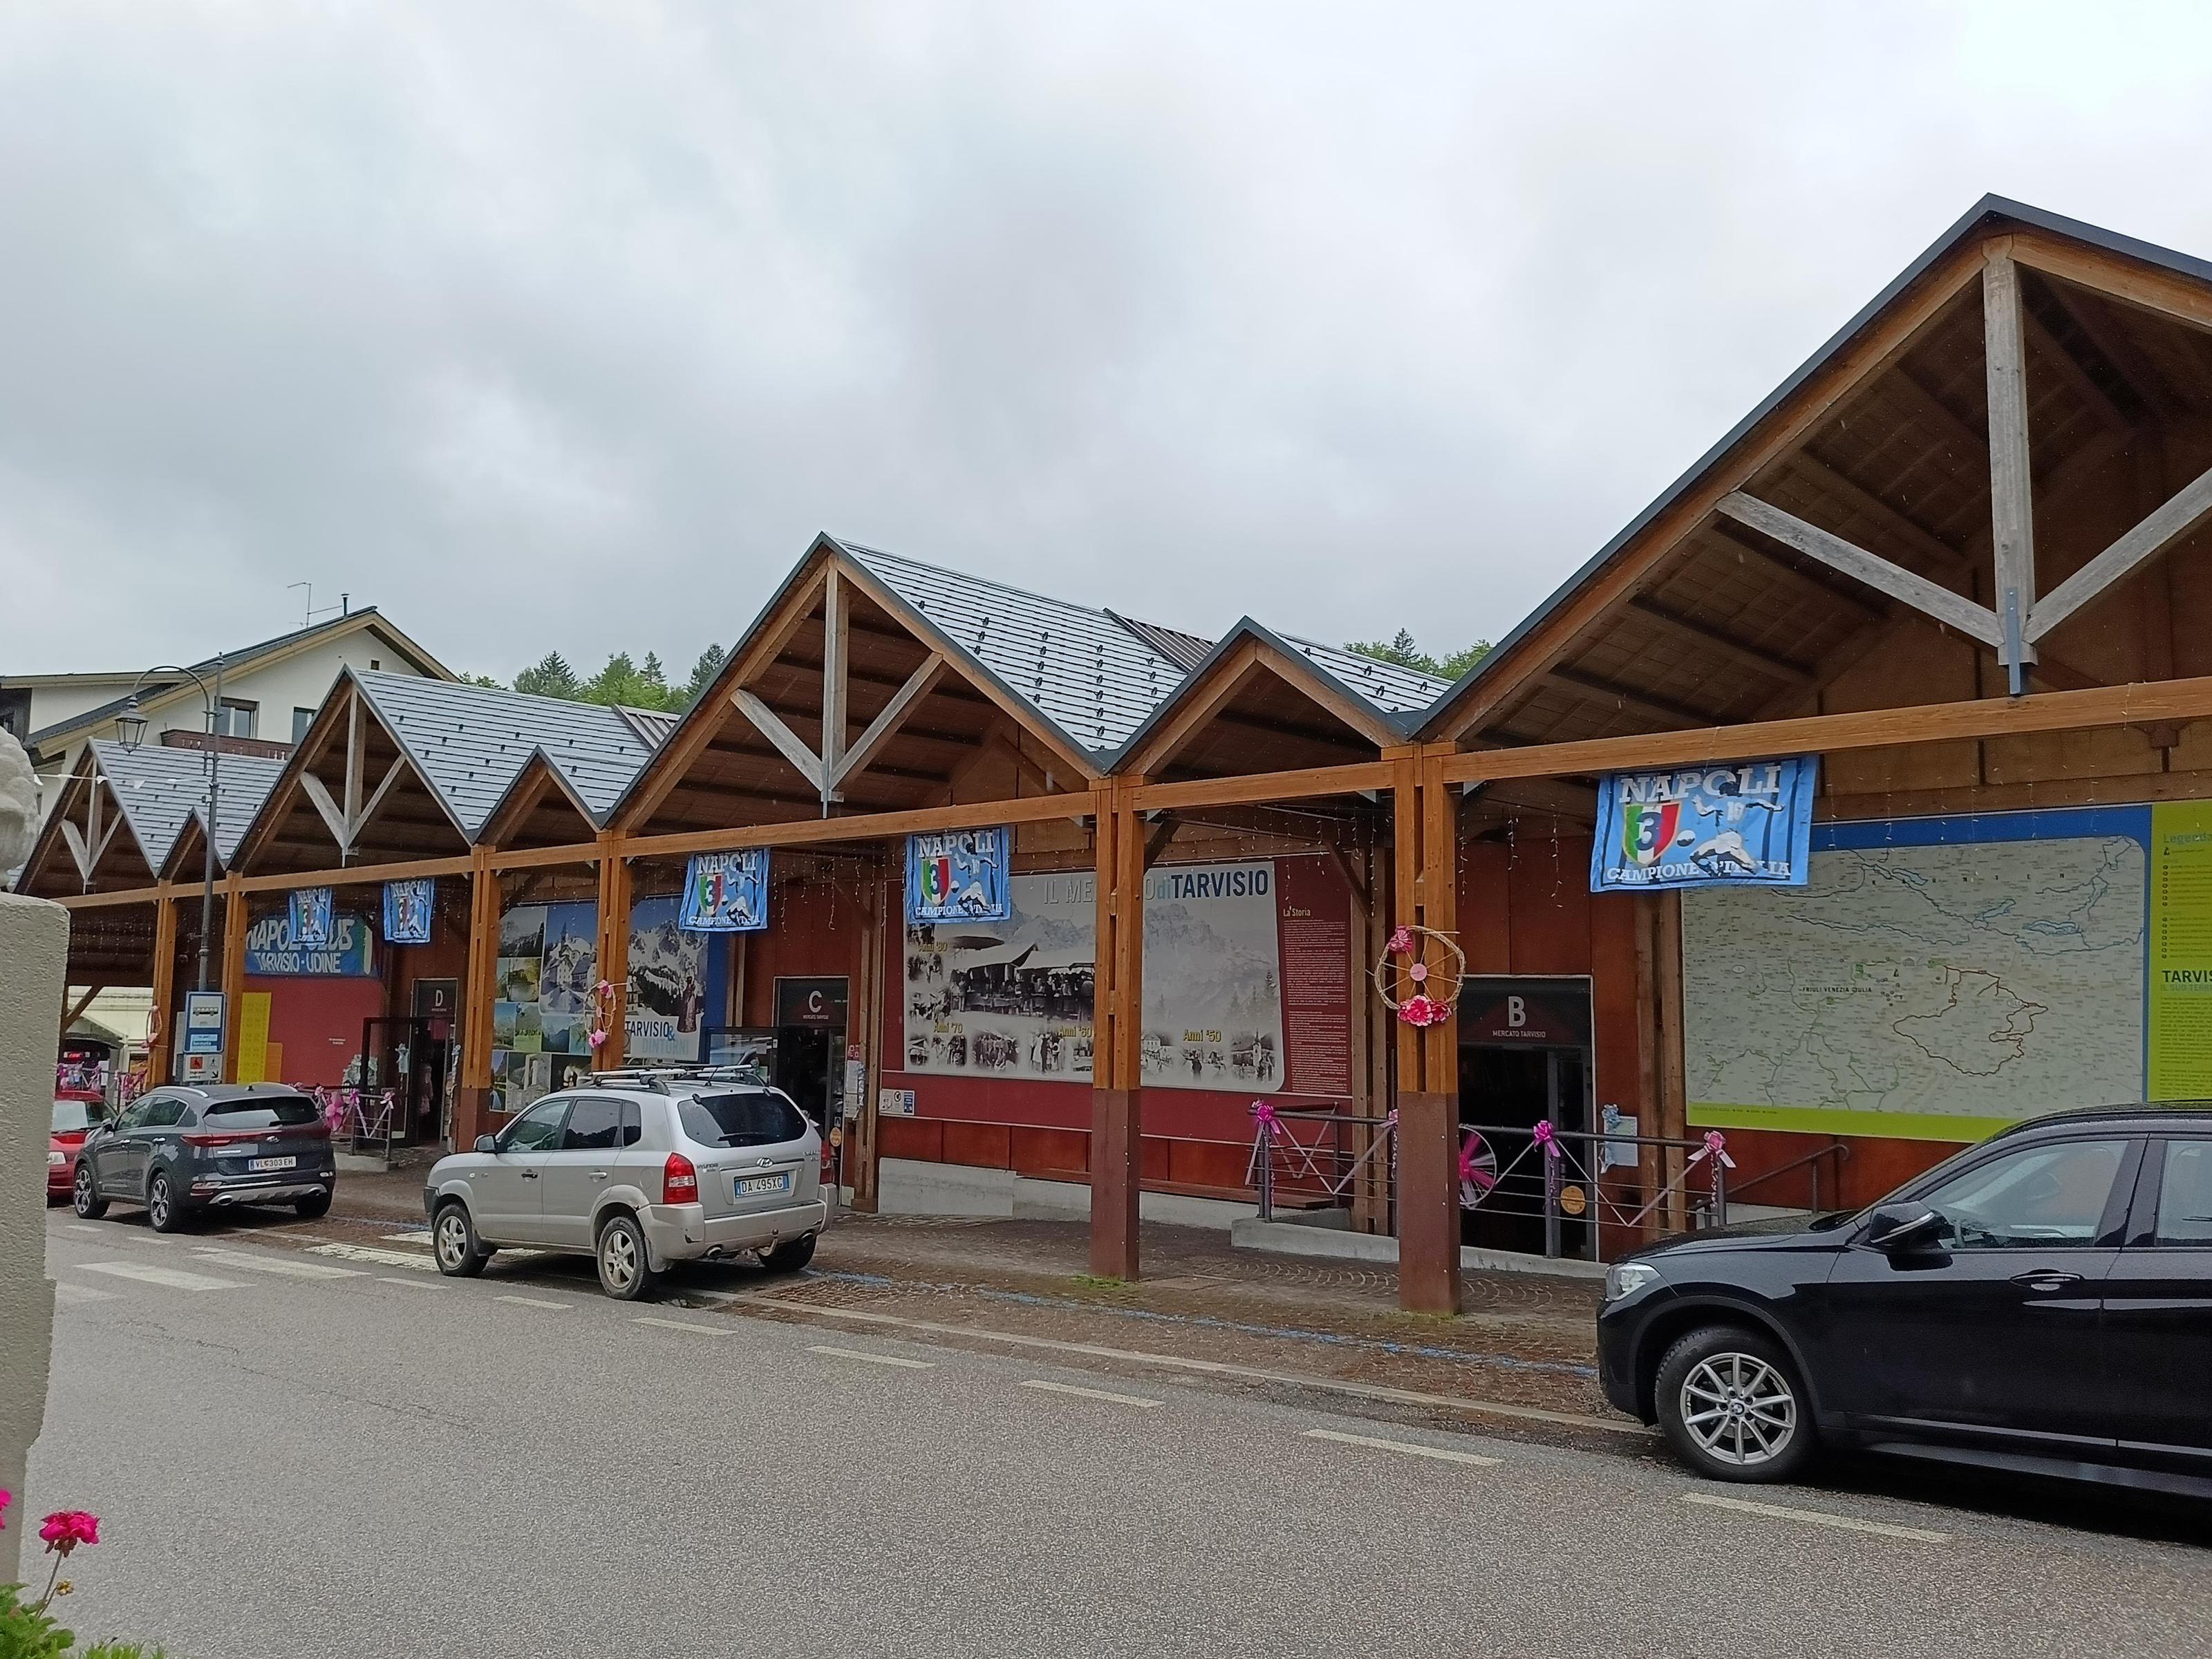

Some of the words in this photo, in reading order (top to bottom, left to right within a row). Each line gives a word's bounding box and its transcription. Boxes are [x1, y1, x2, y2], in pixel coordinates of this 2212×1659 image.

[1619, 765, 1781, 803] NAPOLI
[1634, 811, 1663, 851] 3
[918, 832, 995, 858] NAPOLI
[697, 853, 758, 874] NAPOLI
[1607, 861, 1700, 881] CAMPIONE
[391, 880, 427, 897] NAPOLI
[1044, 881, 1059, 904] IL
[1170, 869, 1268, 899] TARVISIO
[915, 905, 964, 916] CAMPIONE
[1291, 907, 1311, 917] Storia
[254, 952, 300, 973] TARVISIO
[306, 952, 341, 973] UDINE
[2162, 970, 2212, 983] TARVI
[435, 989, 444, 1007] D
[809, 990, 823, 1013] C
[1508, 995, 1526, 1027] B
[625, 1020, 669, 1037] TARVISIO
[1183, 1029, 1203, 1042] Anni
[742, 1181, 753, 1193] DA
